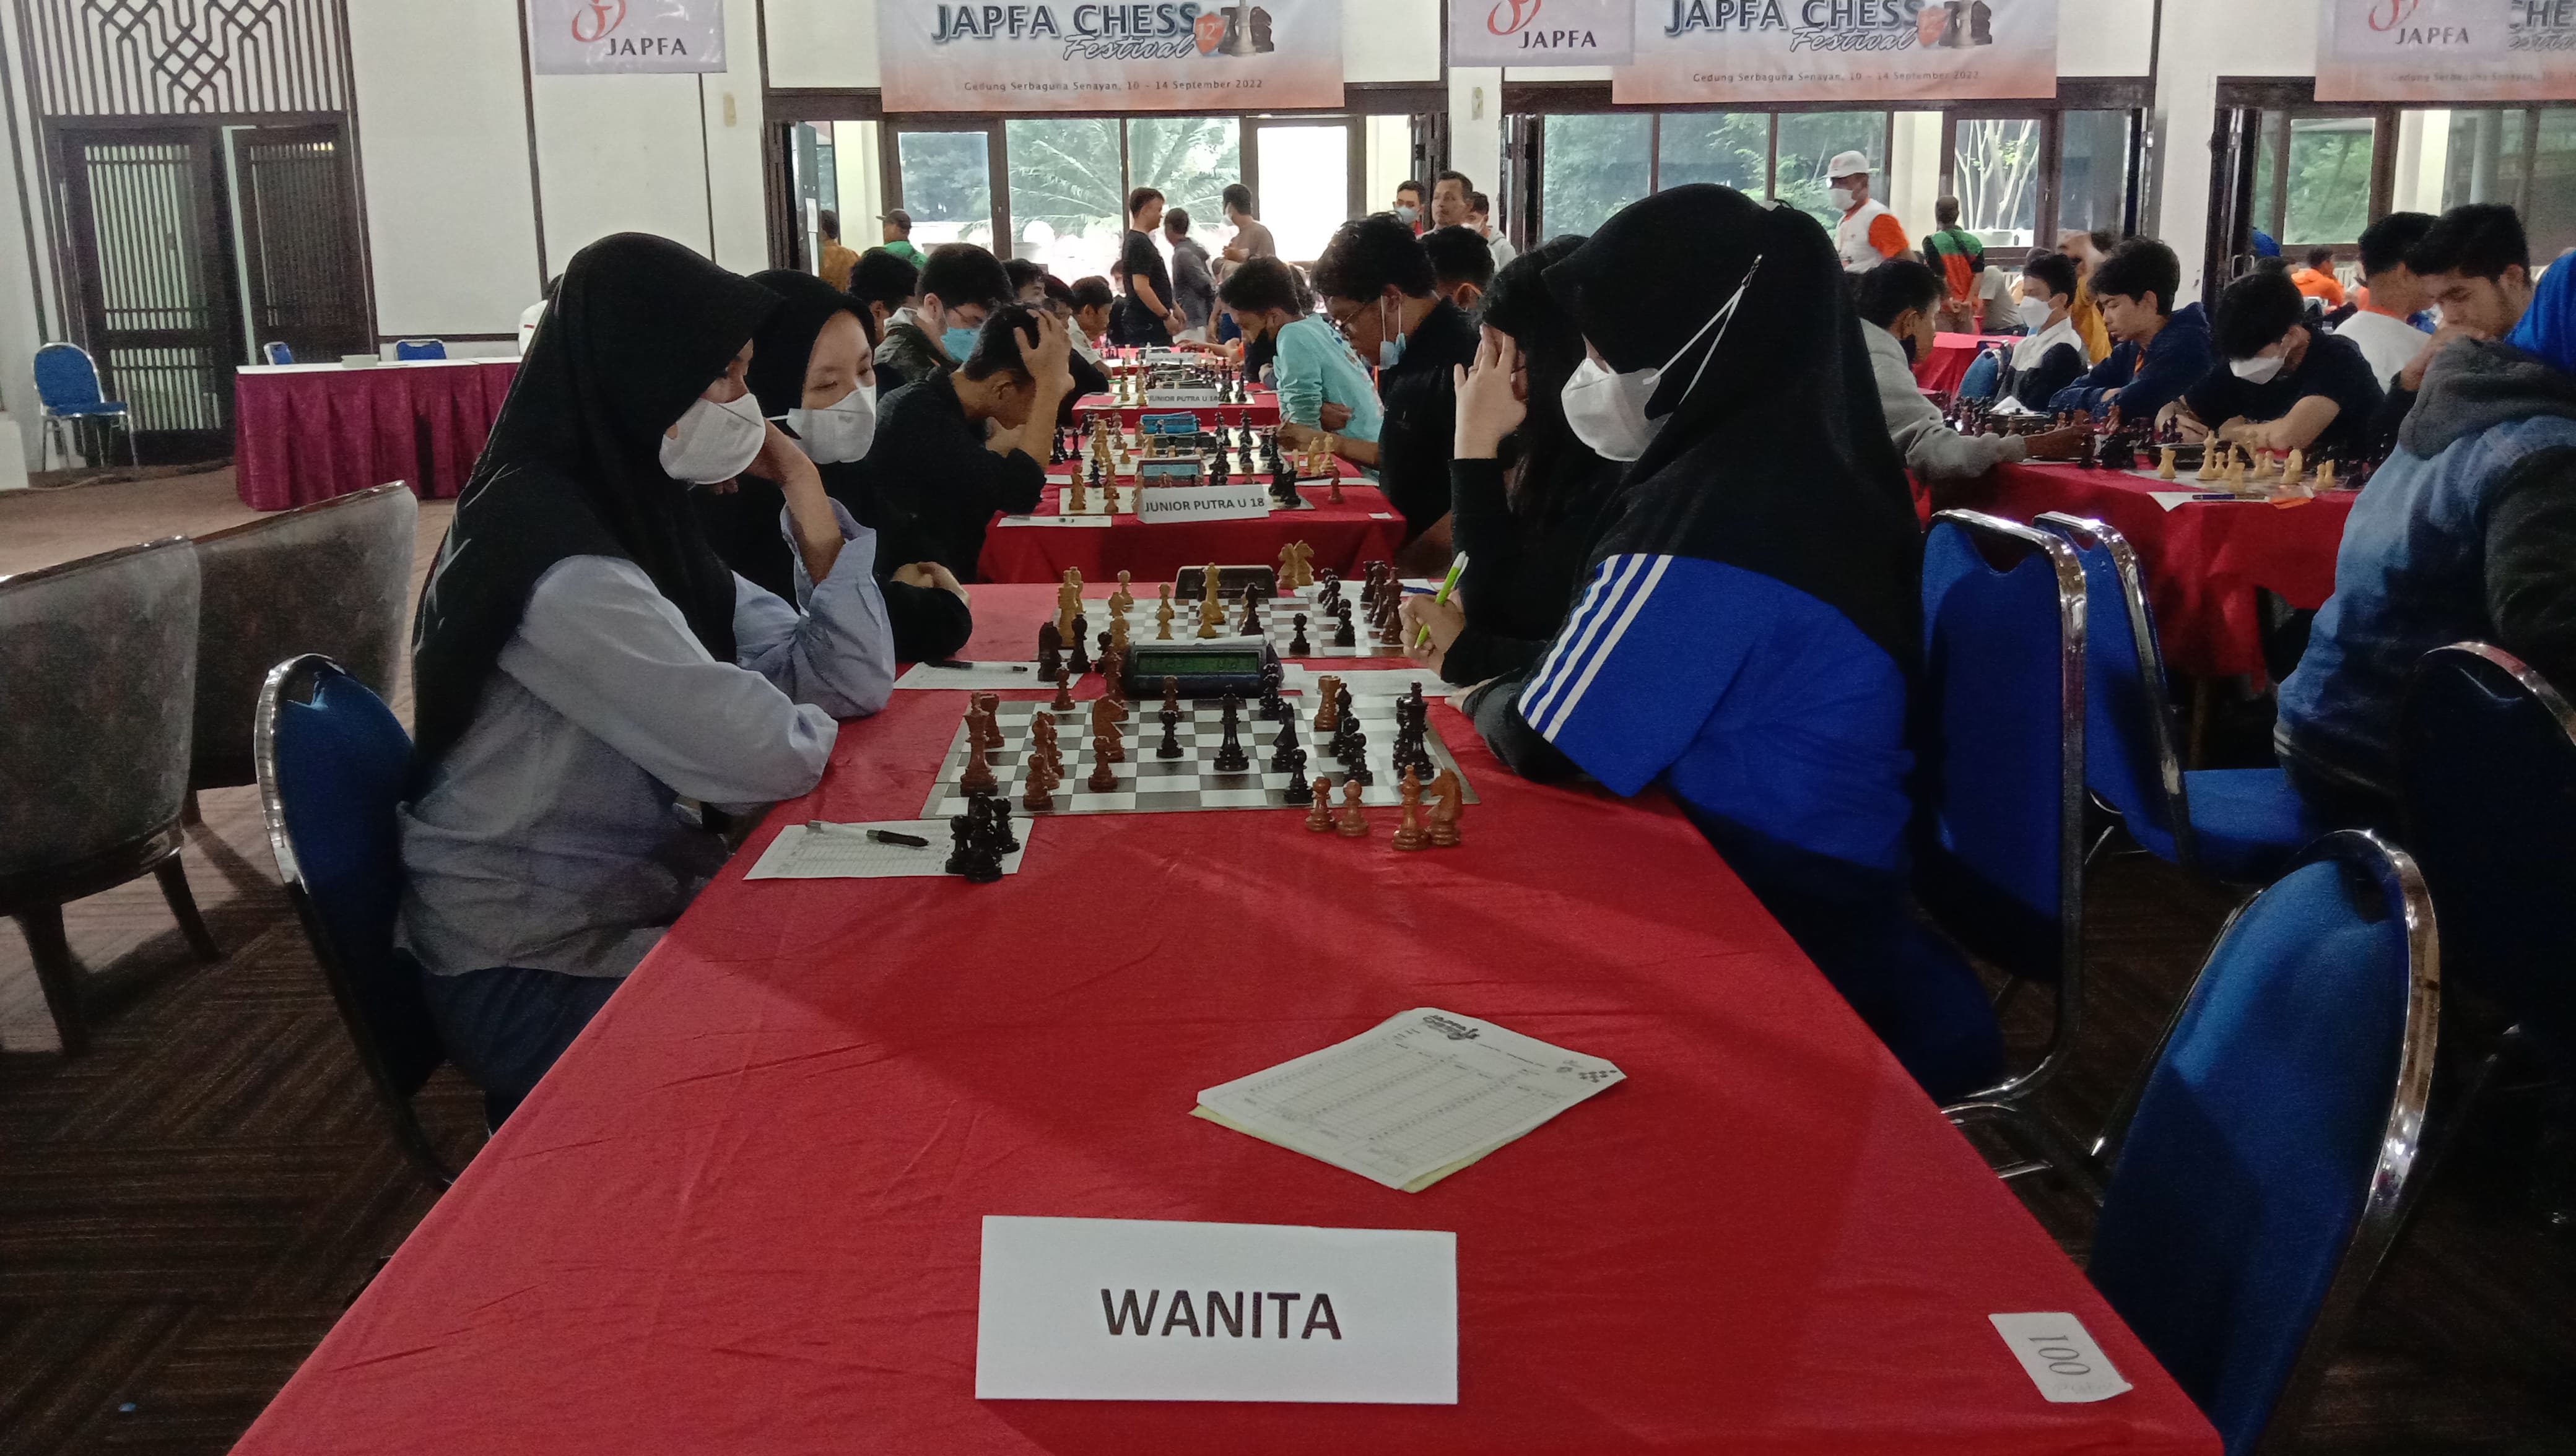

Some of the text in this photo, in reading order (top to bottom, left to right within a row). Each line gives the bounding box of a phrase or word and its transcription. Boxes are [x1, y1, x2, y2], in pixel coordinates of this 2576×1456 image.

[931, 3, 1200, 43] JAPFA CHESS
[1664, 0, 1788, 36] JAPFA
[1802, 0, 1924, 30] CHESS
[606, 38, 688, 56] JAPFA
[1063, 32, 1196, 61] Festival
[1518, 30, 1597, 49] JAPFA
[1790, 26, 1918, 53] Festival
[2395, 27, 2469, 45] JAPFA
[964, 82, 1006, 92] Gedung
[1011, 82, 1069, 92] Serbaguna
[1073, 81, 1122, 93] Senayan,
[1155, 80, 1168, 90] 14
[1173, 80, 1231, 90] September
[1235, 79, 1263, 89] 2022
[1693, 73, 1734, 83] Gedung
[1738, 73, 1793, 83] Serbaguna
[1145, 498, 1264, 513] JUNIOR PUTRA U 18
[1100, 1288, 1342, 1340] WANITA
[2028, 1335, 2091, 1376] 100
